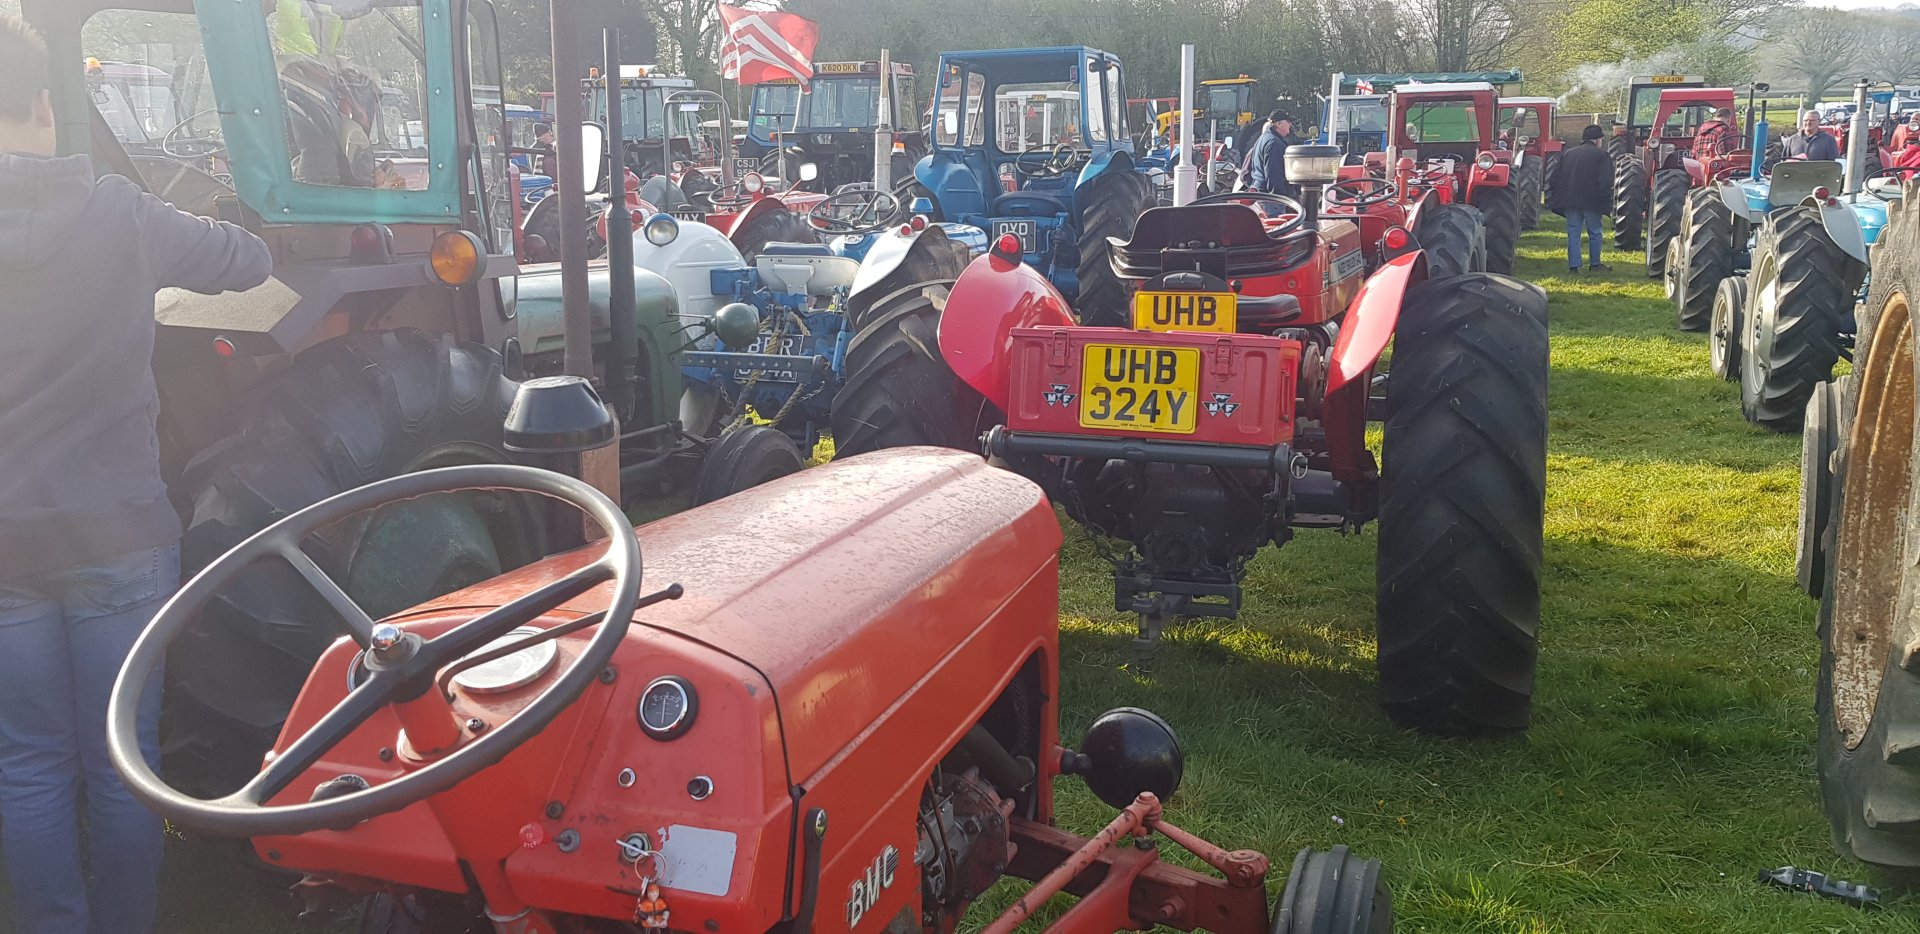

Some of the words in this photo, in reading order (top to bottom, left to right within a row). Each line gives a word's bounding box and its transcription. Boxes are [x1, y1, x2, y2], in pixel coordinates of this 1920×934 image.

[737, 159, 755, 168] CSJ
[1152, 295, 1217, 326] UHB
[1104, 348, 1177, 385] UHB
[1089, 386, 1188, 425] 324Y
[850, 848, 895, 929] BMC
